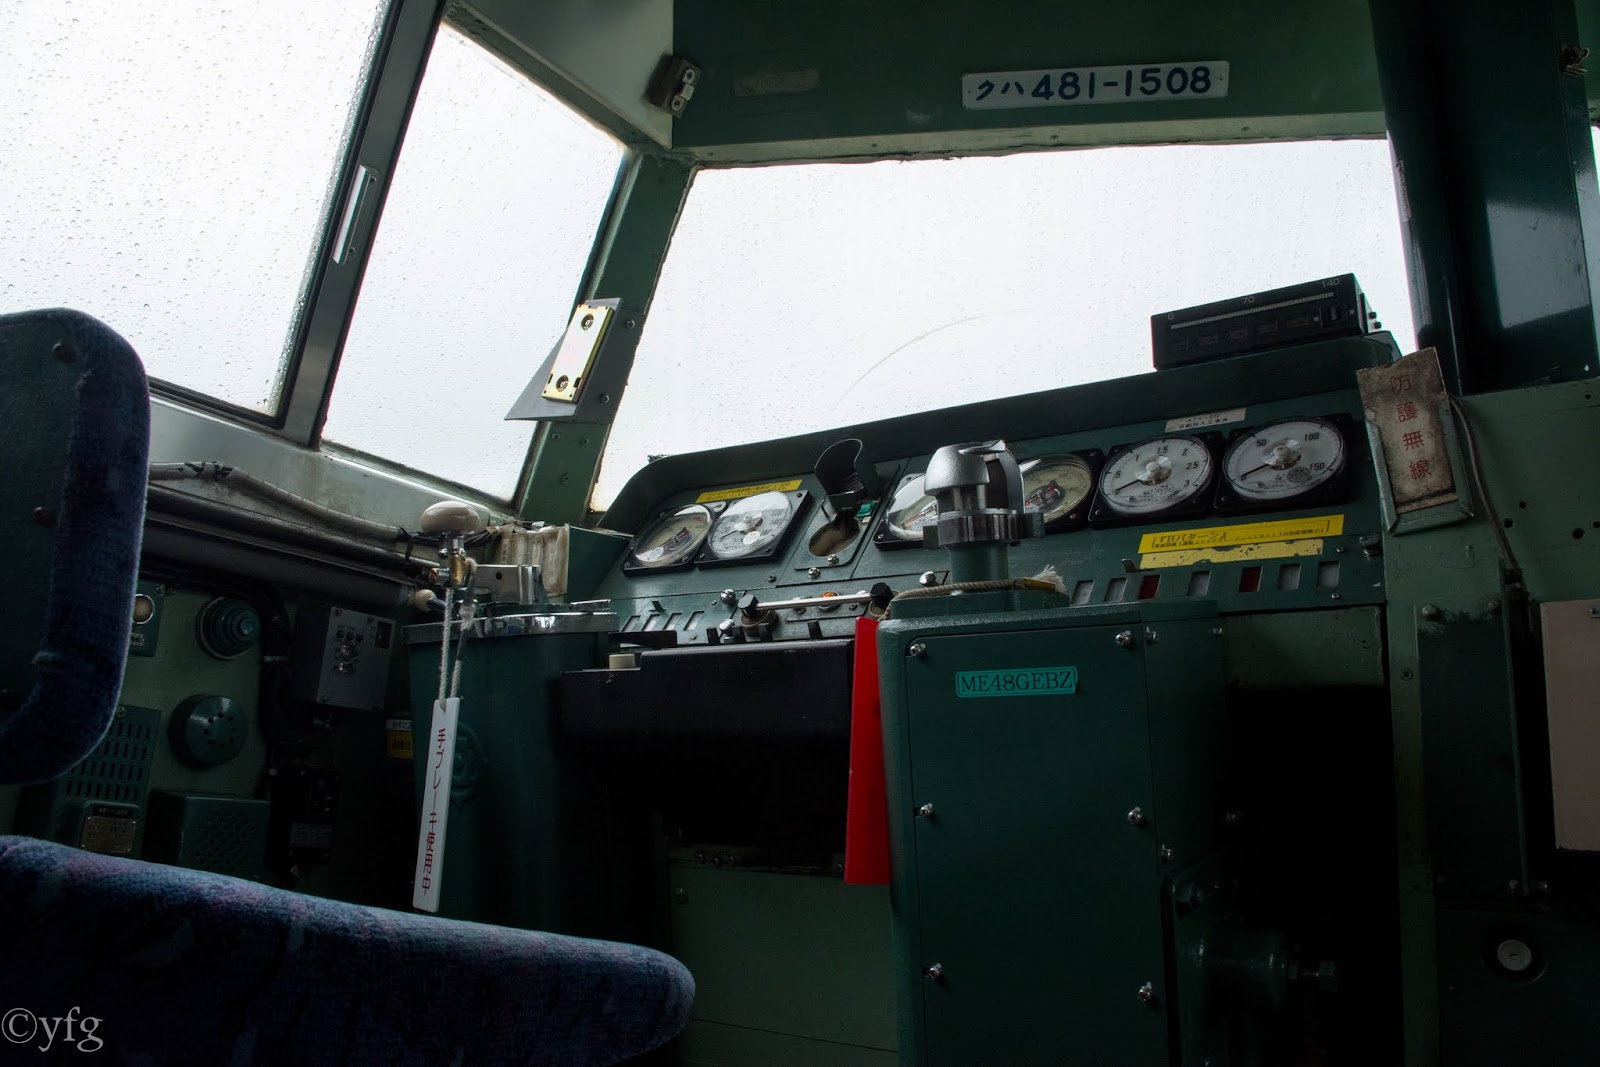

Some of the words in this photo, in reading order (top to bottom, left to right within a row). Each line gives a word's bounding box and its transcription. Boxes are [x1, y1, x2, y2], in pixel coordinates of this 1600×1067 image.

[976, 66, 1212, 101] クハ481-1508
[1321, 278, 1340, 288] 140
[1243, 296, 1255, 305] 70
[1389, 374, 1432, 481] 防護無線
[1304, 432, 1320, 441] 100
[1256, 438, 1267, 447] 50
[1157, 445, 1169, 455] 1.5
[1182, 448, 1188, 456] 2
[1186, 461, 1199, 470] 2.5
[1309, 462, 1325, 471] 150
[1183, 479, 1190, 487] 3
[960, 671, 1073, 692] ME48GEBZ
